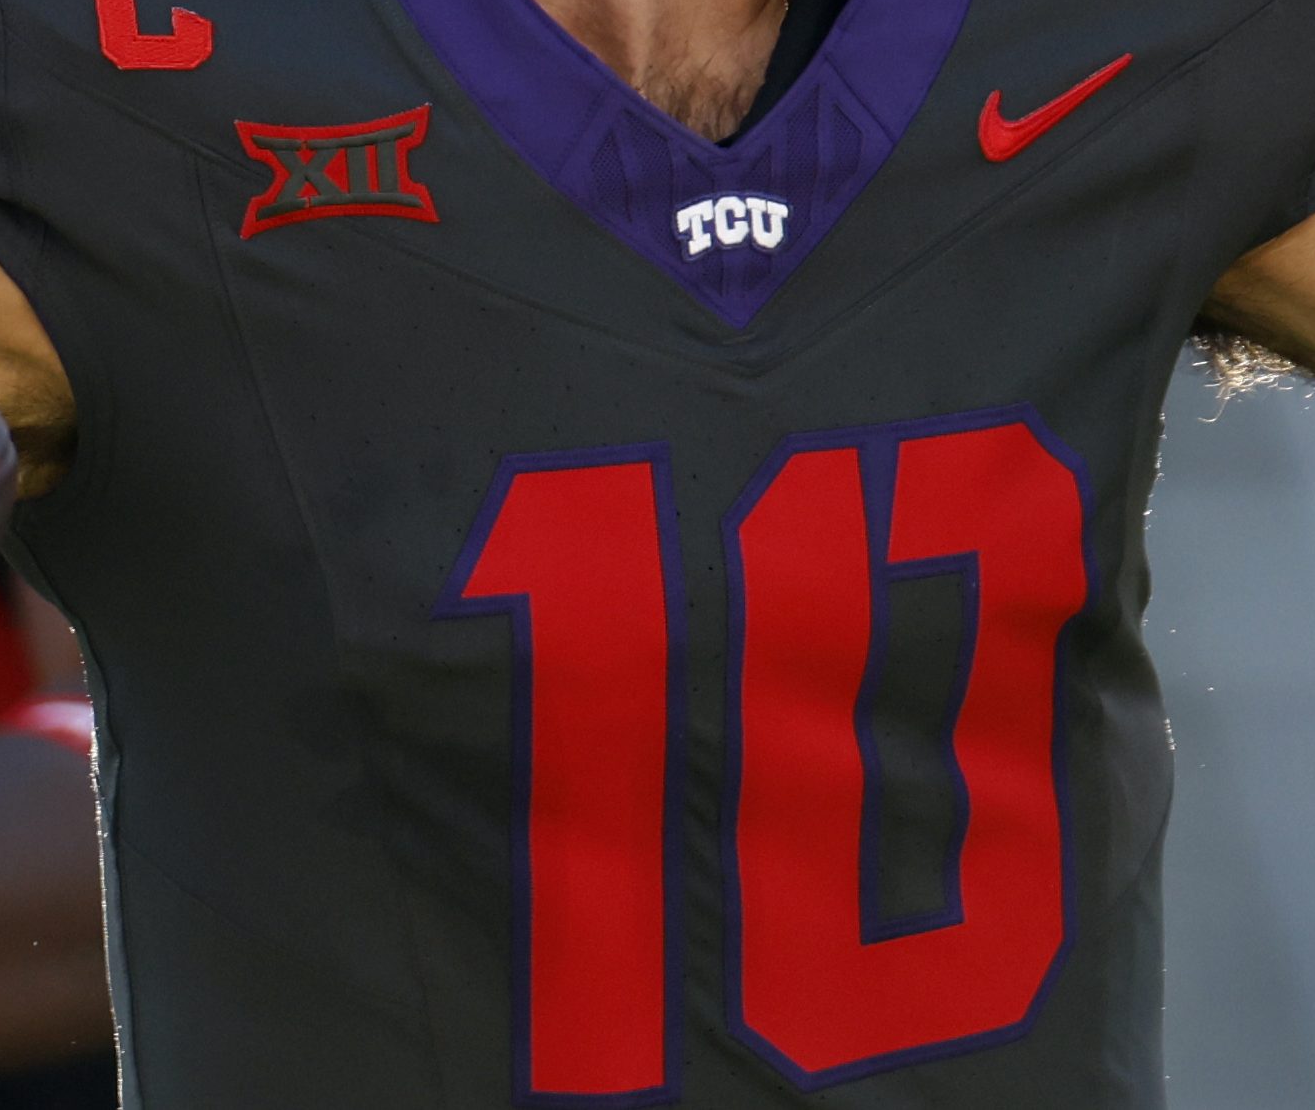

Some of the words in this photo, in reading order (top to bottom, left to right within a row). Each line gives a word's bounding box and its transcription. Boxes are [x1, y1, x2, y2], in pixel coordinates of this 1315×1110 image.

[251, 121, 424, 221] XII
[676, 195, 789, 256] TCU
[432, 401, 1099, 1107] 10
